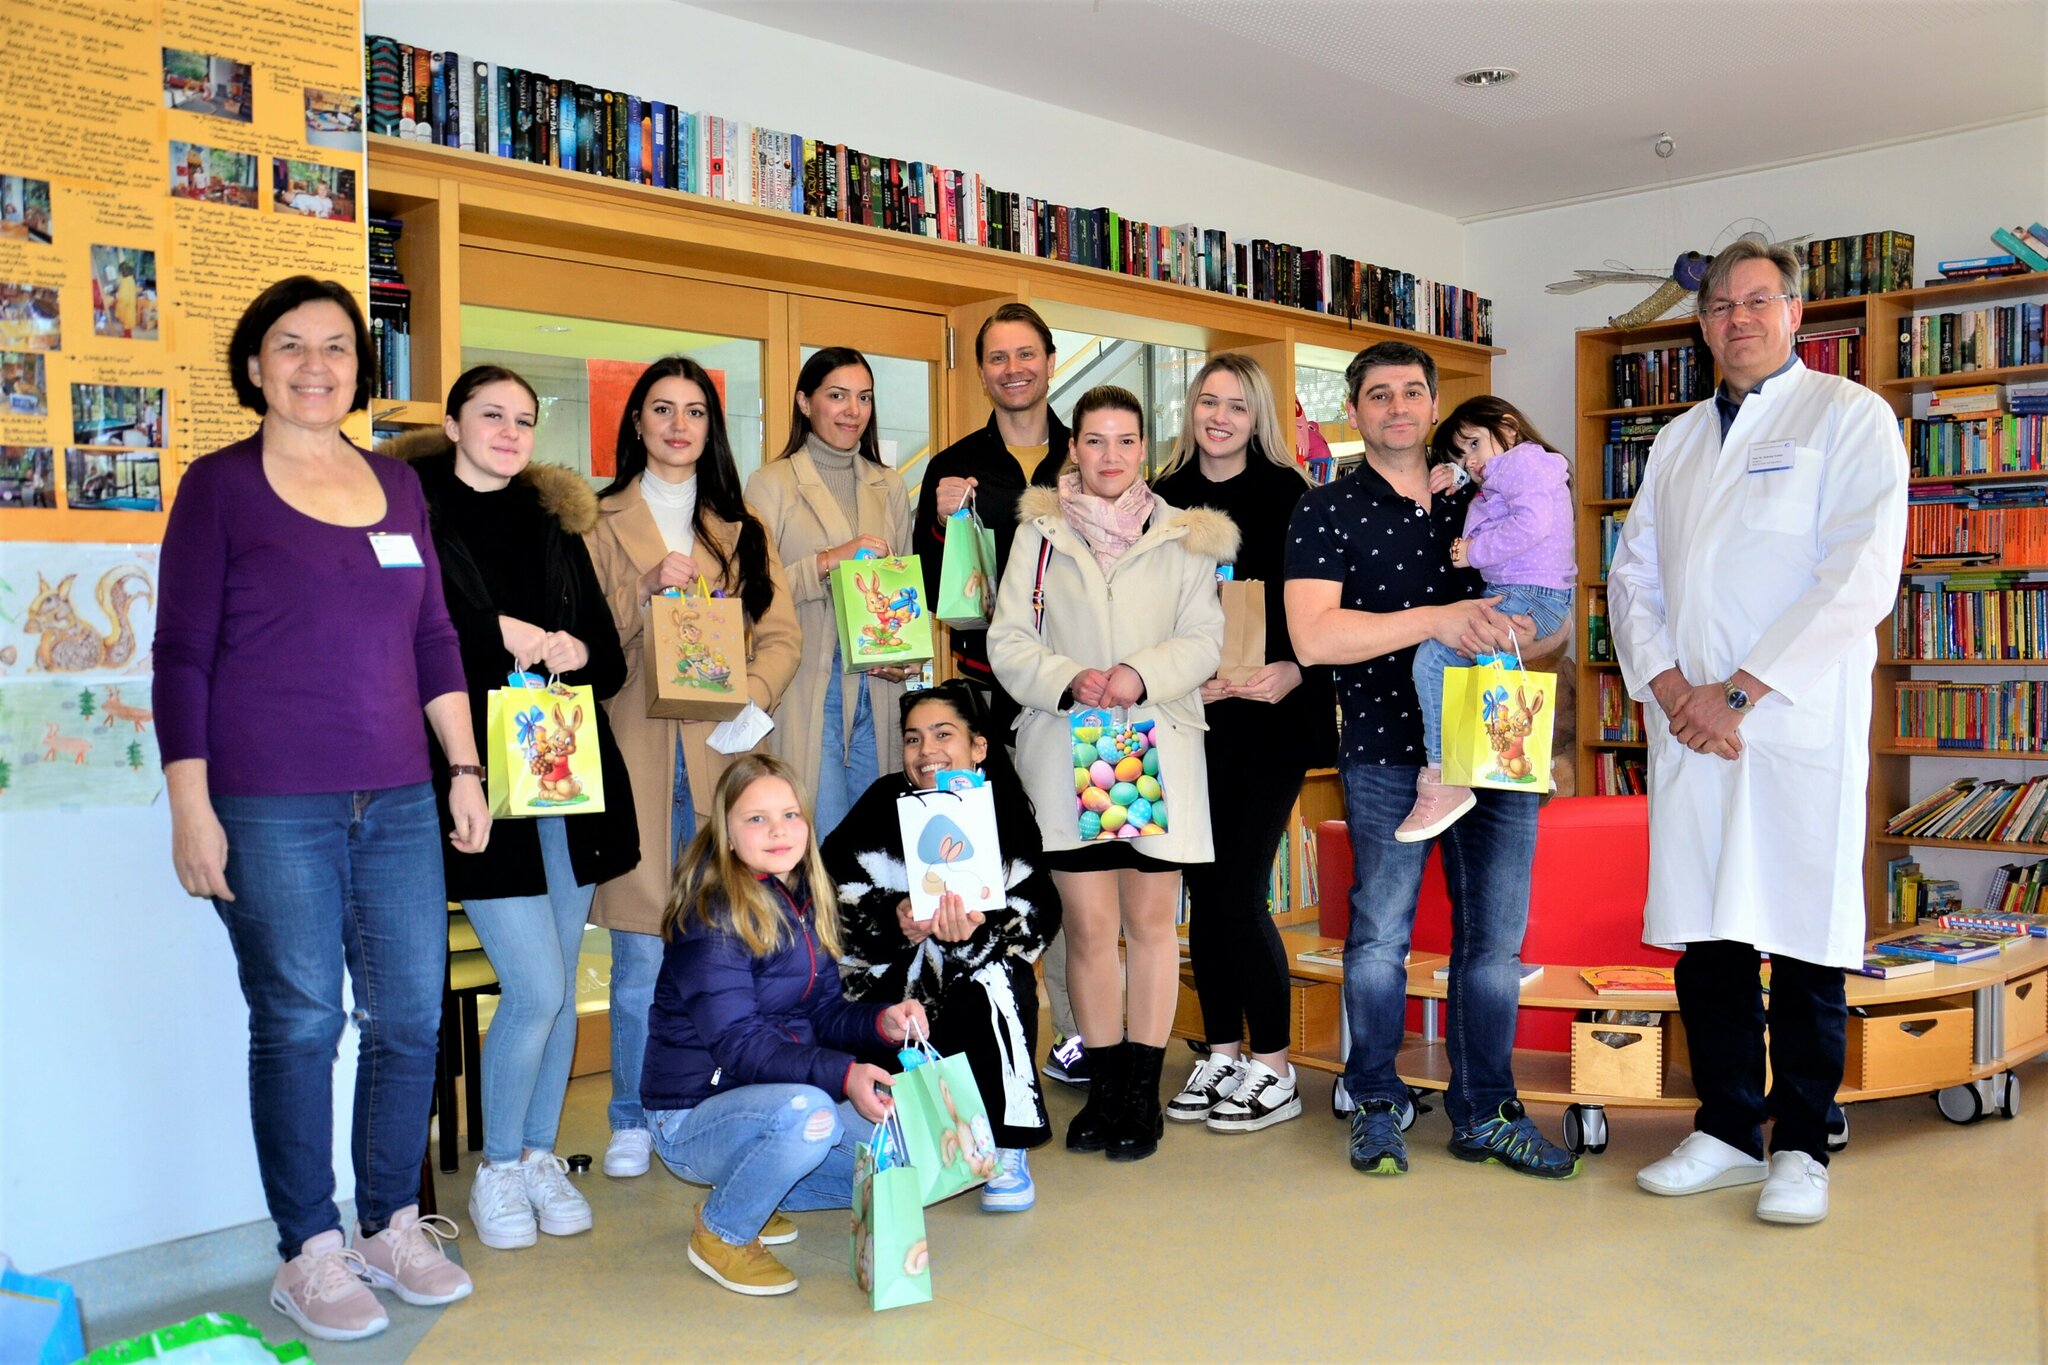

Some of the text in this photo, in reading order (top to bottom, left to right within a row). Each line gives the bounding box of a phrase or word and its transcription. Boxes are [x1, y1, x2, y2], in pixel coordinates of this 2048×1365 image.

[549, 98, 557, 116] MAN
[549, 120, 557, 135] EVE
[1941, 342, 1951, 363] Twig
